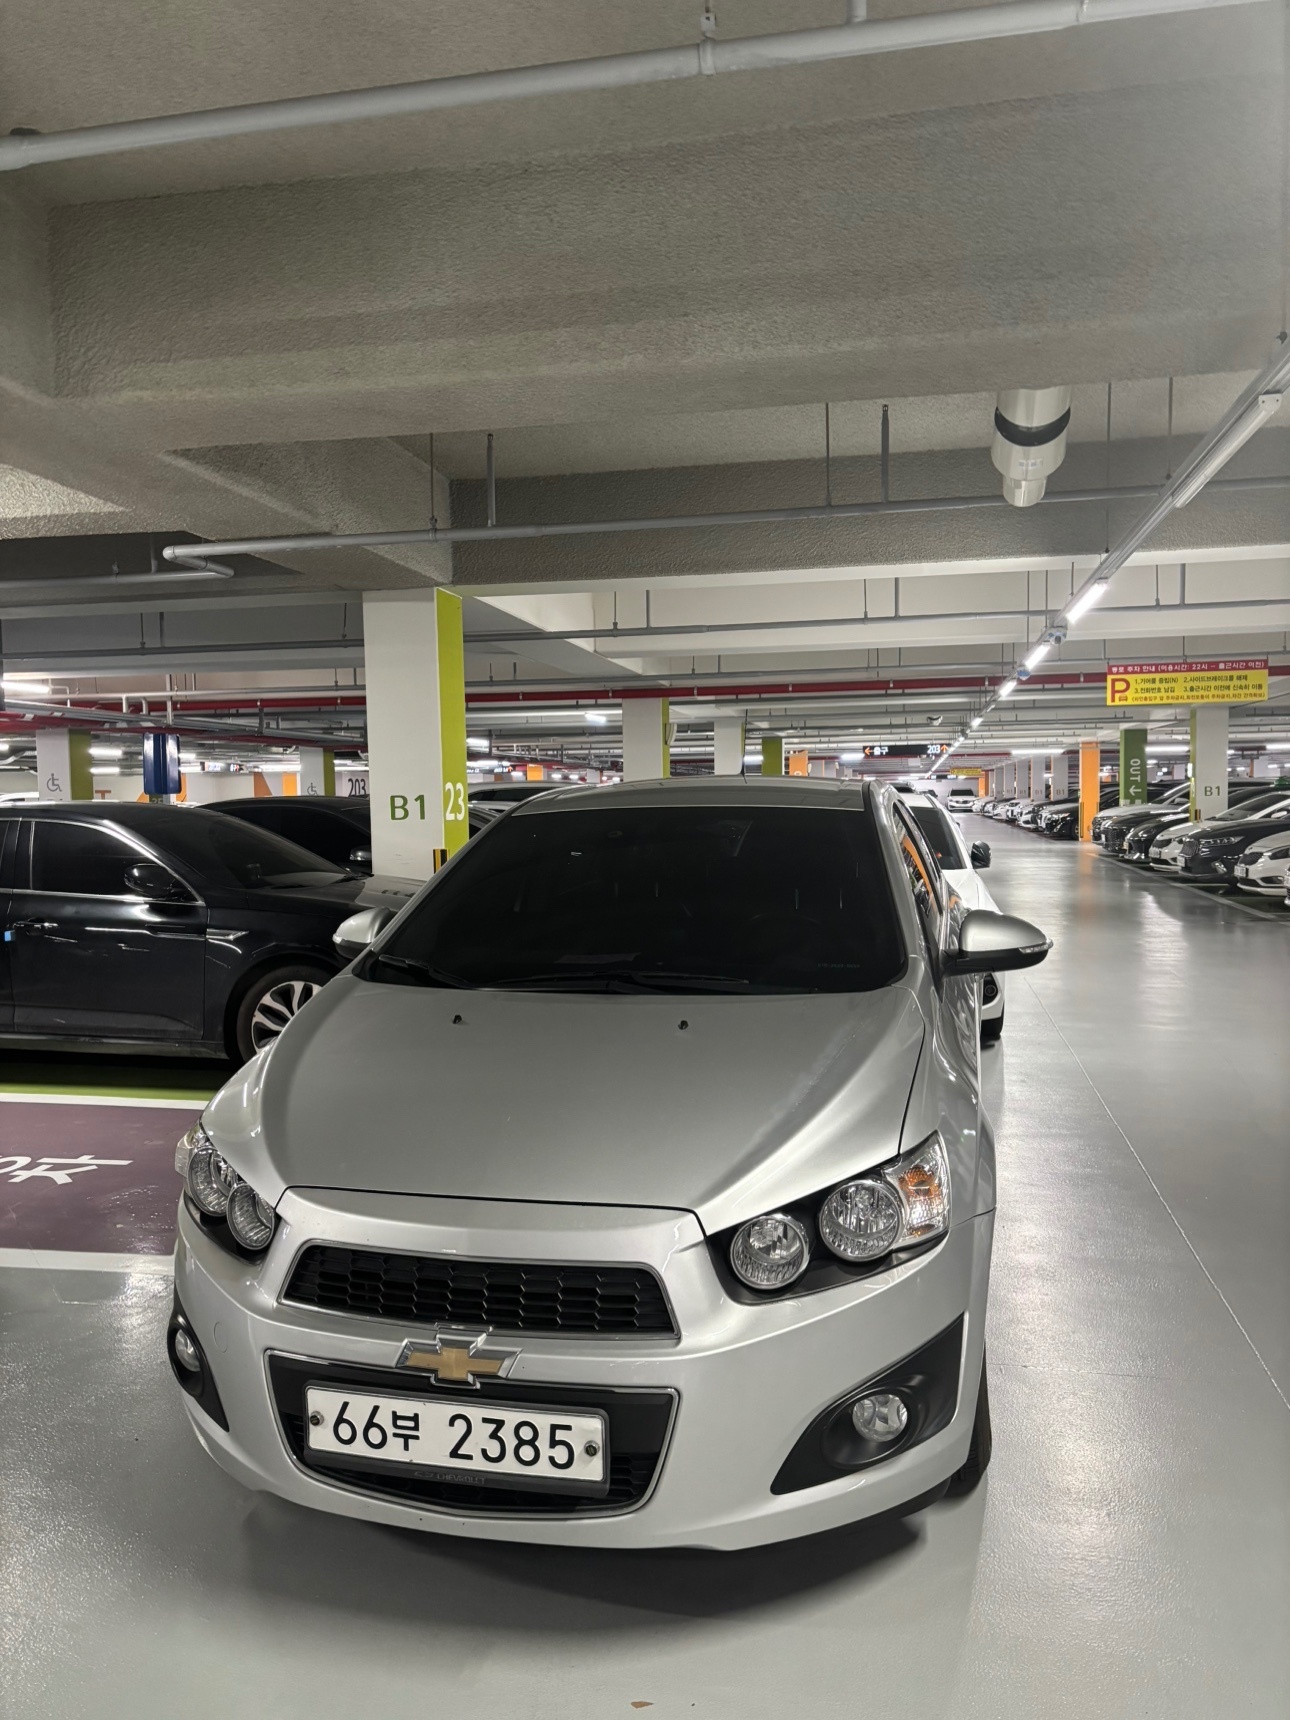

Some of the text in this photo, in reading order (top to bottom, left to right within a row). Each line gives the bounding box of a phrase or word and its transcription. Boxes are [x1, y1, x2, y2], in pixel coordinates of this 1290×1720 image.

[1127, 665, 1140, 673] 주차
[1110, 677, 1131, 703] P
[927, 745, 940, 754] 203
[1130, 758, 1141, 783] OUT
[347, 778, 367, 797] 203
[1204, 786, 1221, 797] B1
[390, 794, 426, 821] B1
[445, 782, 465, 821] 23
[333, 1401, 575, 1470] 66부 2385
